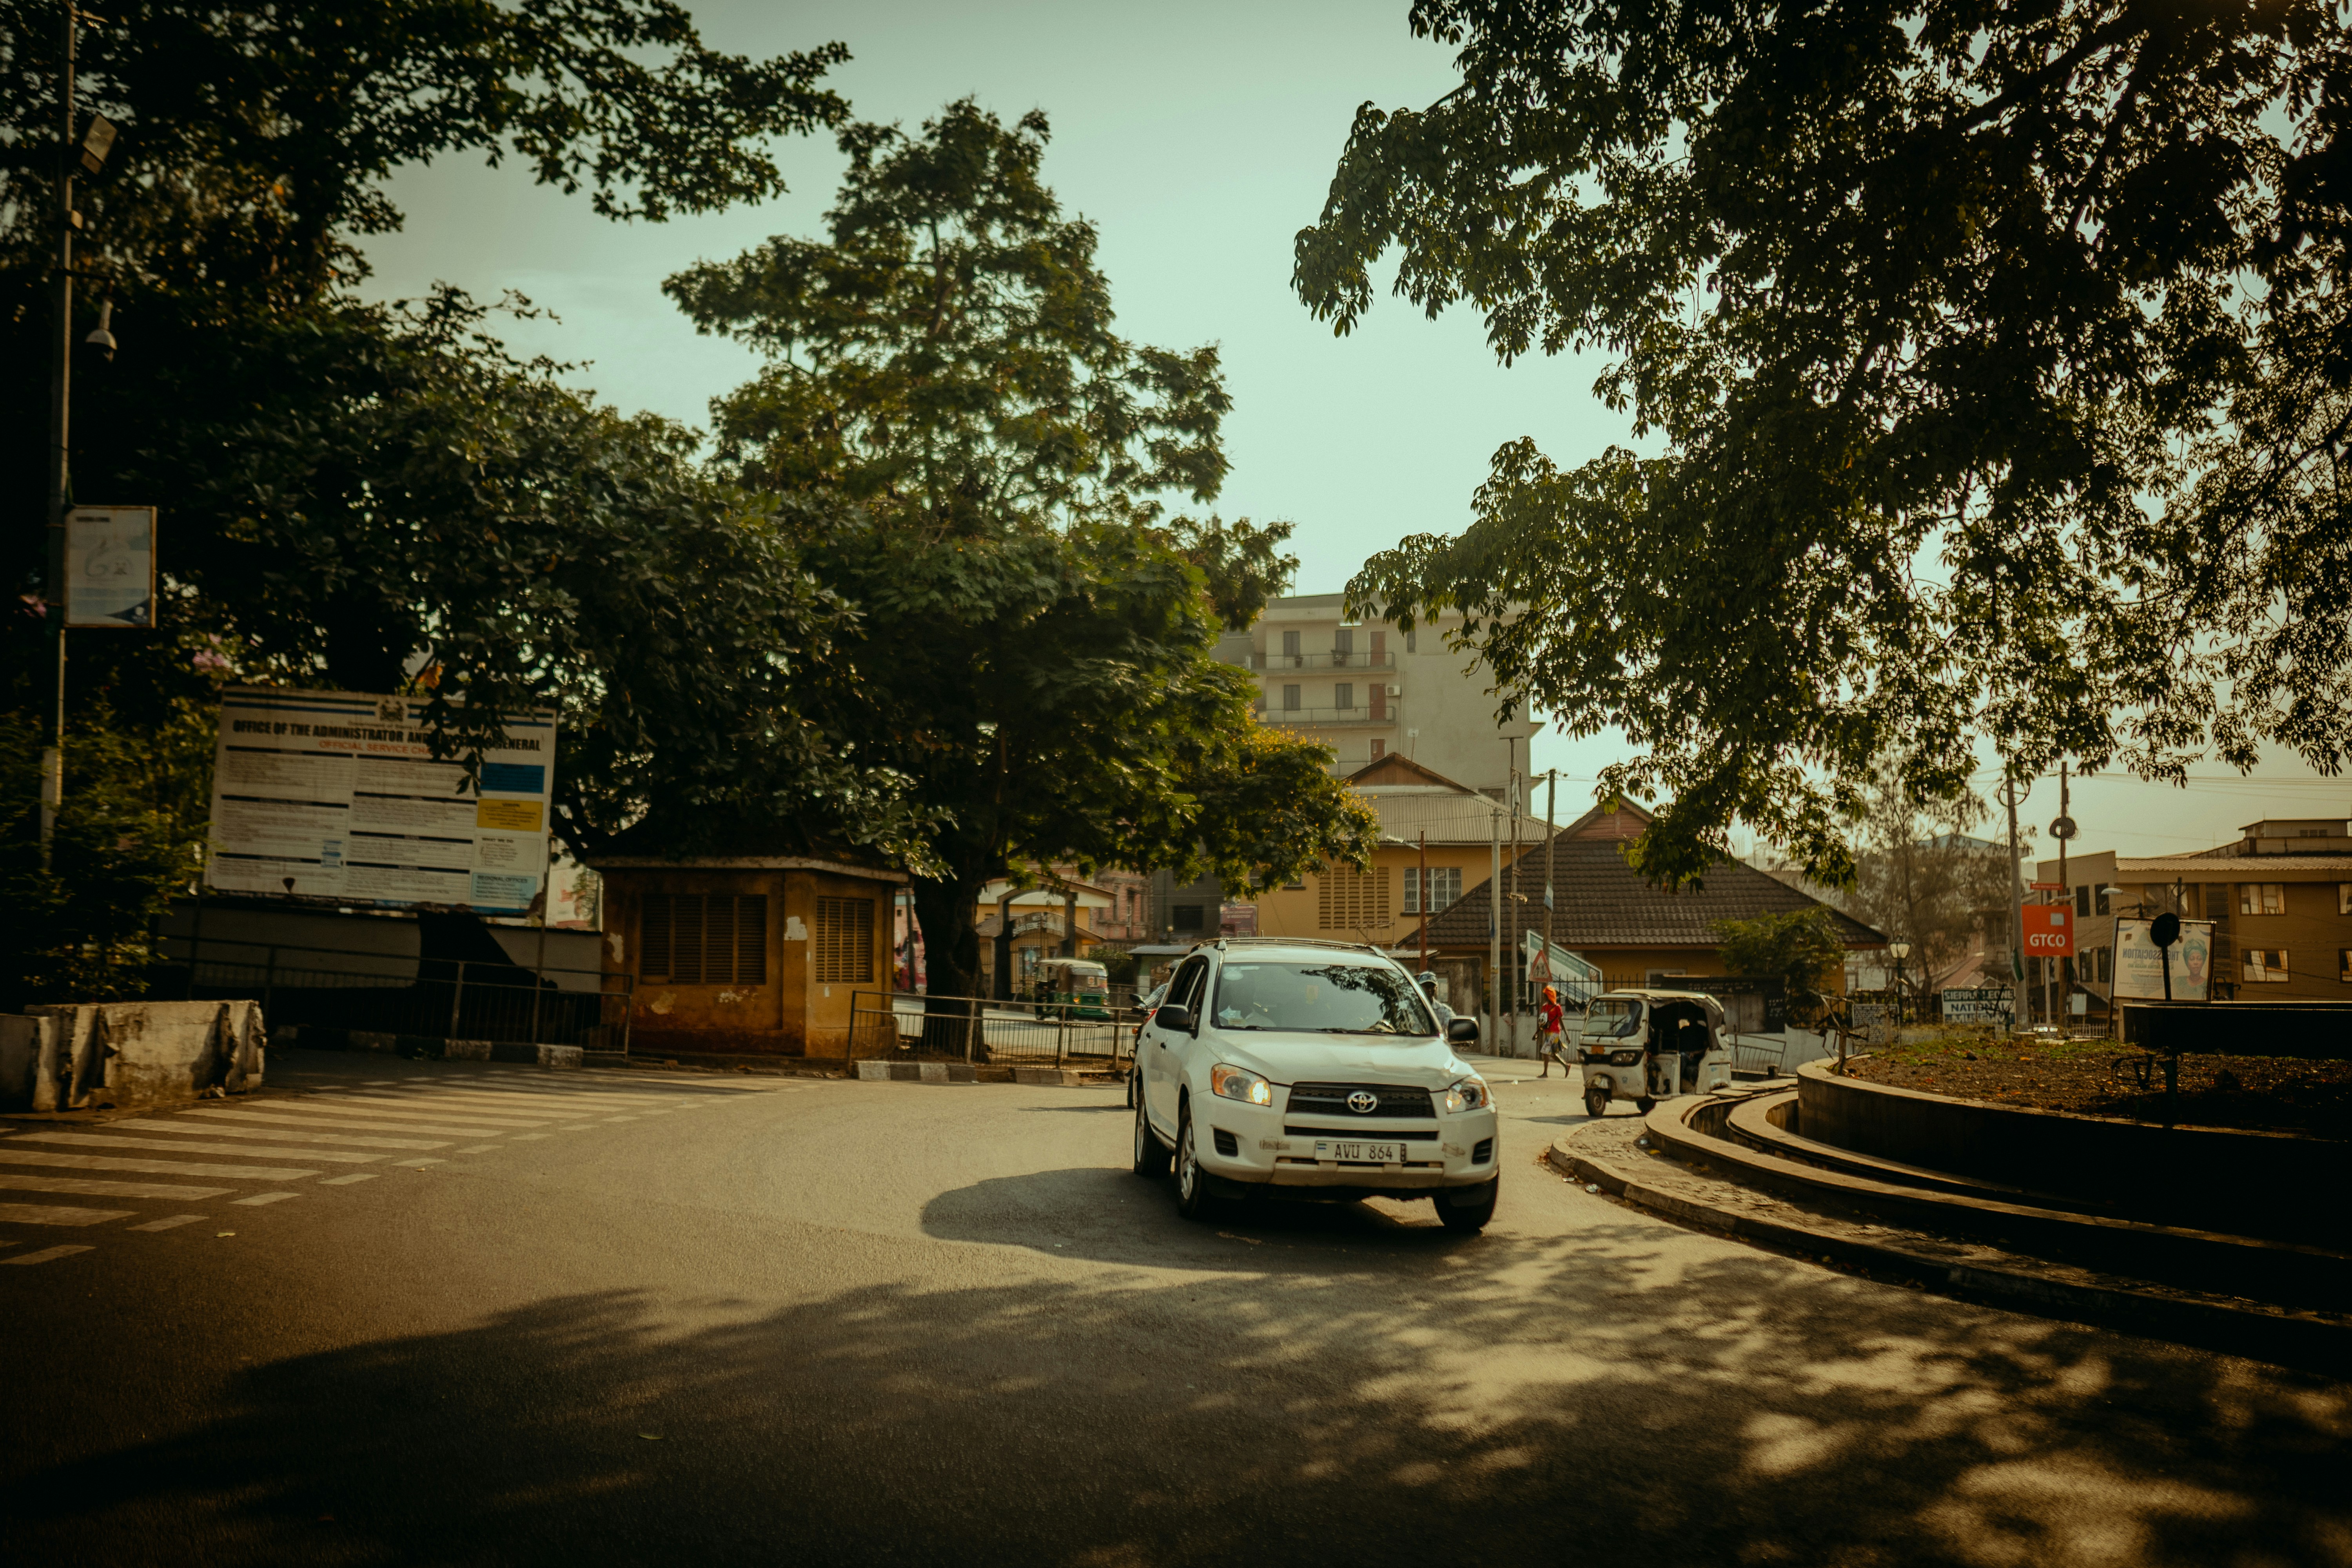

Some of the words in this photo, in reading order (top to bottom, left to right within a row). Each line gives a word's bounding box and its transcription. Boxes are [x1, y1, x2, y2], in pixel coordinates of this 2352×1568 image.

[233, 720, 271, 734] OFFICE
[274, 722, 287, 734] OF
[290, 724, 310, 736] THE
[313, 725, 404, 742] ADMINISTRATOR
[319, 740, 363, 751] OFFICIAL
[366, 742, 408, 754] SERVICE
[2029, 933, 2065, 947] GTCO
[1335, 1144, 1359, 1159] AVU
[1369, 1145, 1392, 1160] 864
